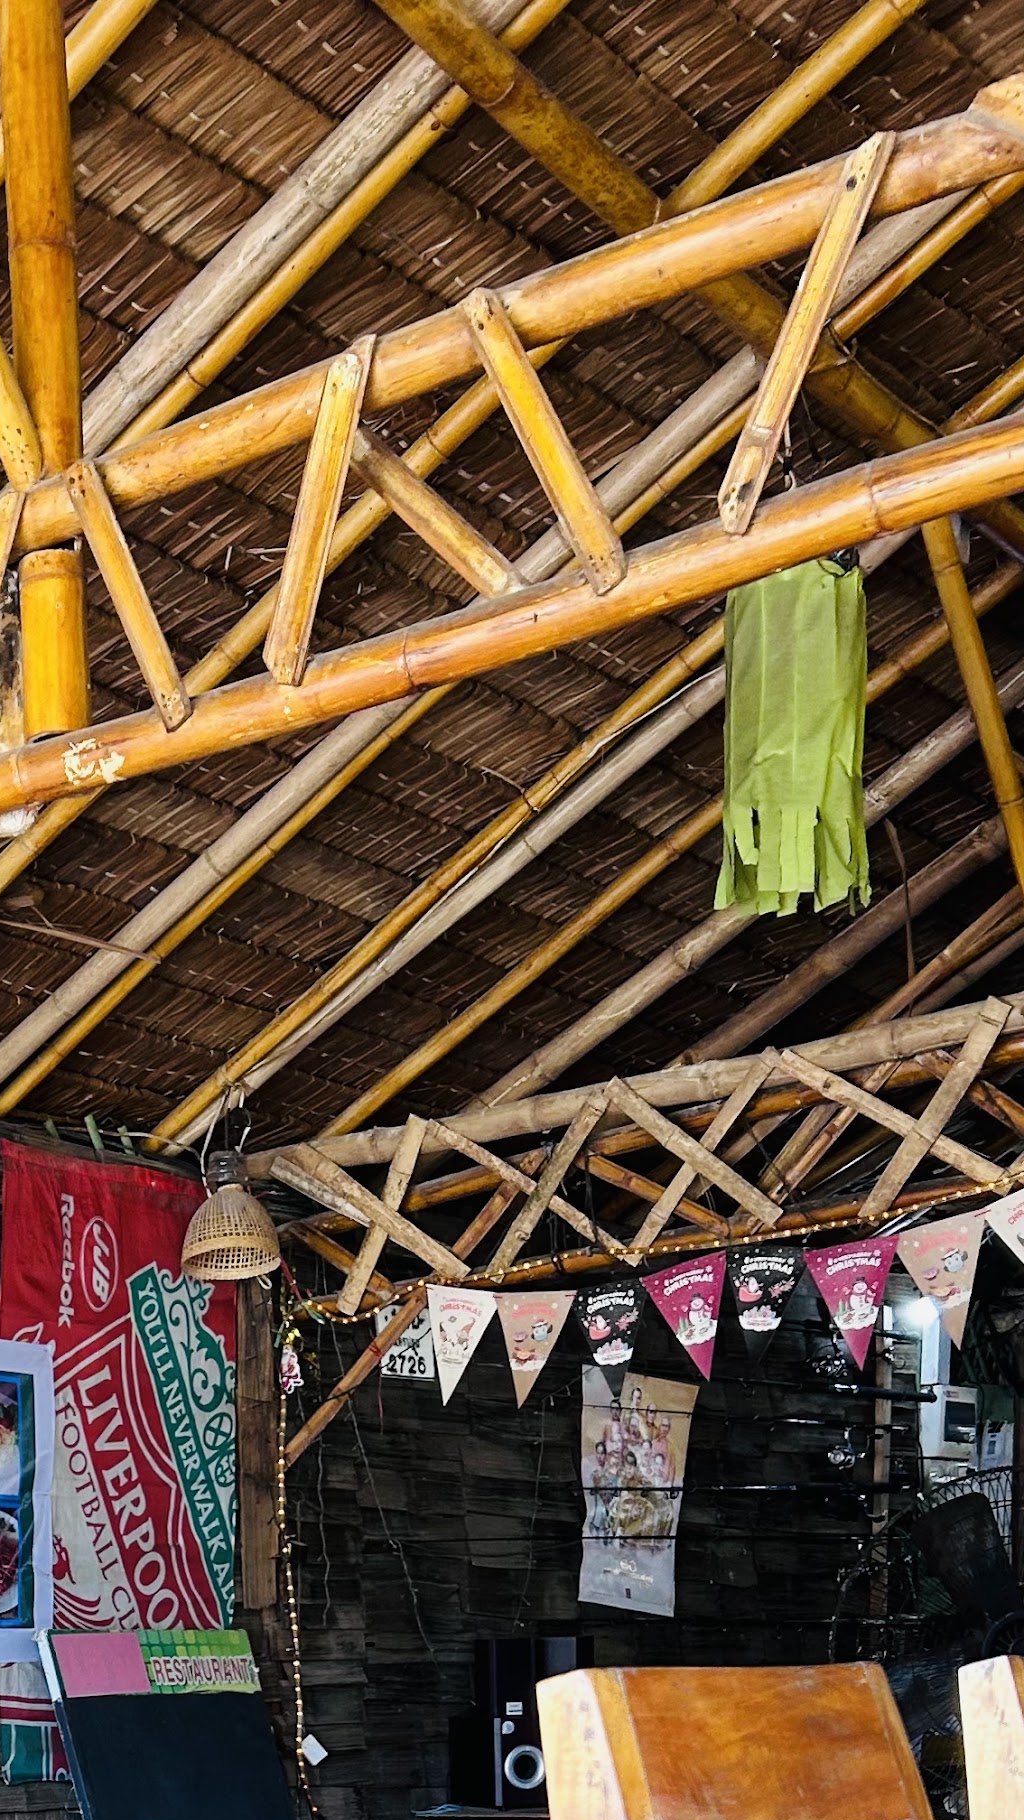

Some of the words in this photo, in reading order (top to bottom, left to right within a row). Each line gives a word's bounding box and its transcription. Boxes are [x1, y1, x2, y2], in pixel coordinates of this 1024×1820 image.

[58, 1193, 75, 1329] Reebok
[740, 1261, 794, 1275] CHRISTMAS
[826, 1257, 882, 1276] CHRISTMAS
[386, 1353, 426, 1375] 2726
[138, 1277, 174, 1382] YOU'LL
[162, 1378, 202, 1480] NEVER
[190, 1470, 227, 1561] WALK
[213, 1562, 235, 1625] ALO
[56, 1403, 119, 1581] FOOTBALL
[111, 1586, 140, 1631] CL
[77, 1364, 185, 1630] LIVERPOO
[151, 1657, 251, 1684] RESTAURANT
